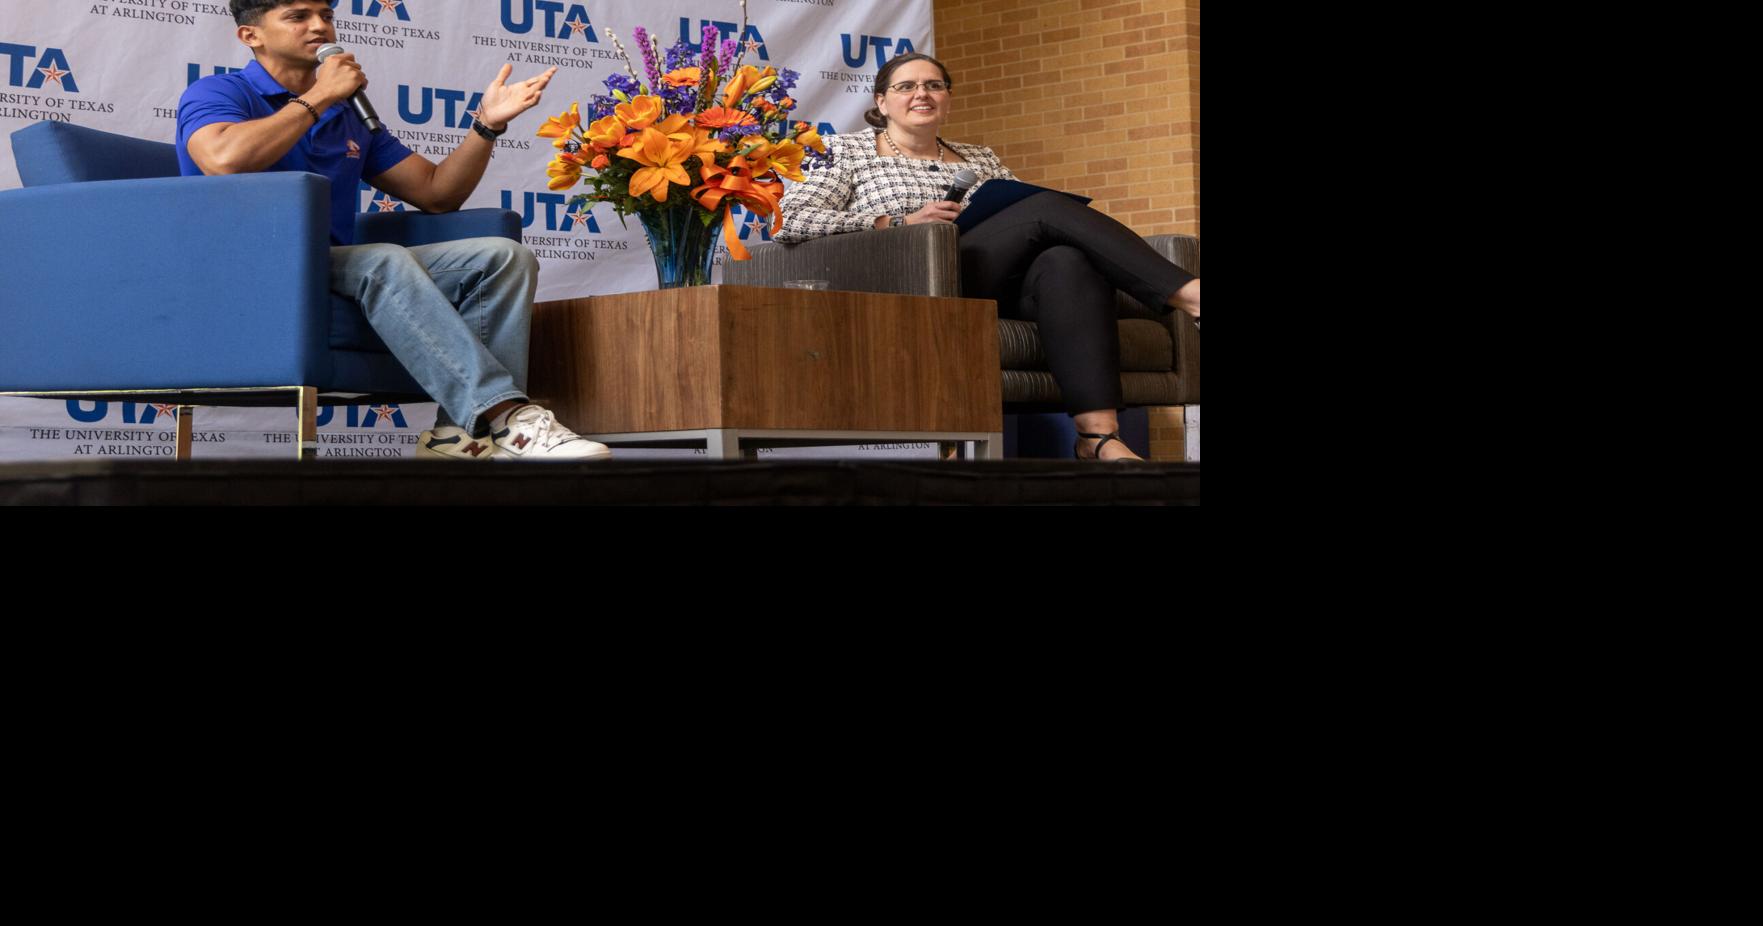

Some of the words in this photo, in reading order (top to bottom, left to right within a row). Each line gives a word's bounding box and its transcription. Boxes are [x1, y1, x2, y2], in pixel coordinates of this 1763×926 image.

[171, 0, 189, 11] OF
[90, 4, 108, 15] AT
[112, 7, 195, 25] ARLINGTON
[500, 0, 599, 43] UTA
[336, 19, 379, 33] ERSITY
[382, 25, 398, 35] OF
[401, 27, 440, 40] TEXAS
[472, 35, 497, 47] THE
[500, 39, 570, 55] UNIVERSITY
[572, 47, 588, 57] OF
[680, 16, 769, 61] UTA
[0, 42, 80, 93] TA
[507, 52, 522, 62] AT
[525, 54, 593, 69] ARLINGTON
[820, 71, 839, 81] THE
[841, 73, 877, 83] UNIVE
[846, 85, 858, 93] AT
[0, 93, 41, 106] RSITY
[45, 97, 64, 108] OF
[69, 100, 114, 113] TEXAS
[0, 107, 71, 122] LINGTON
[501, 190, 601, 233] UTA
[523, 236, 571, 247] VERSITY
[574, 240, 590, 248] OF
[593, 240, 628, 250] TEXAS
[535, 249, 596, 260] RLINGTON
[30, 429, 61, 440] THE
[65, 430, 154, 441] UNIVERSITY
[158, 431, 177, 442] OF
[191, 432, 226, 442] EXAS
[263, 433, 291, 443] THE
[295, 434, 374, 444] IVERSITY
[378, 434, 396, 444] OF
[73, 445, 93, 455] AT
[97, 445, 177, 456] ARLINGTO
[325, 447, 402, 457] ARLINGTON
